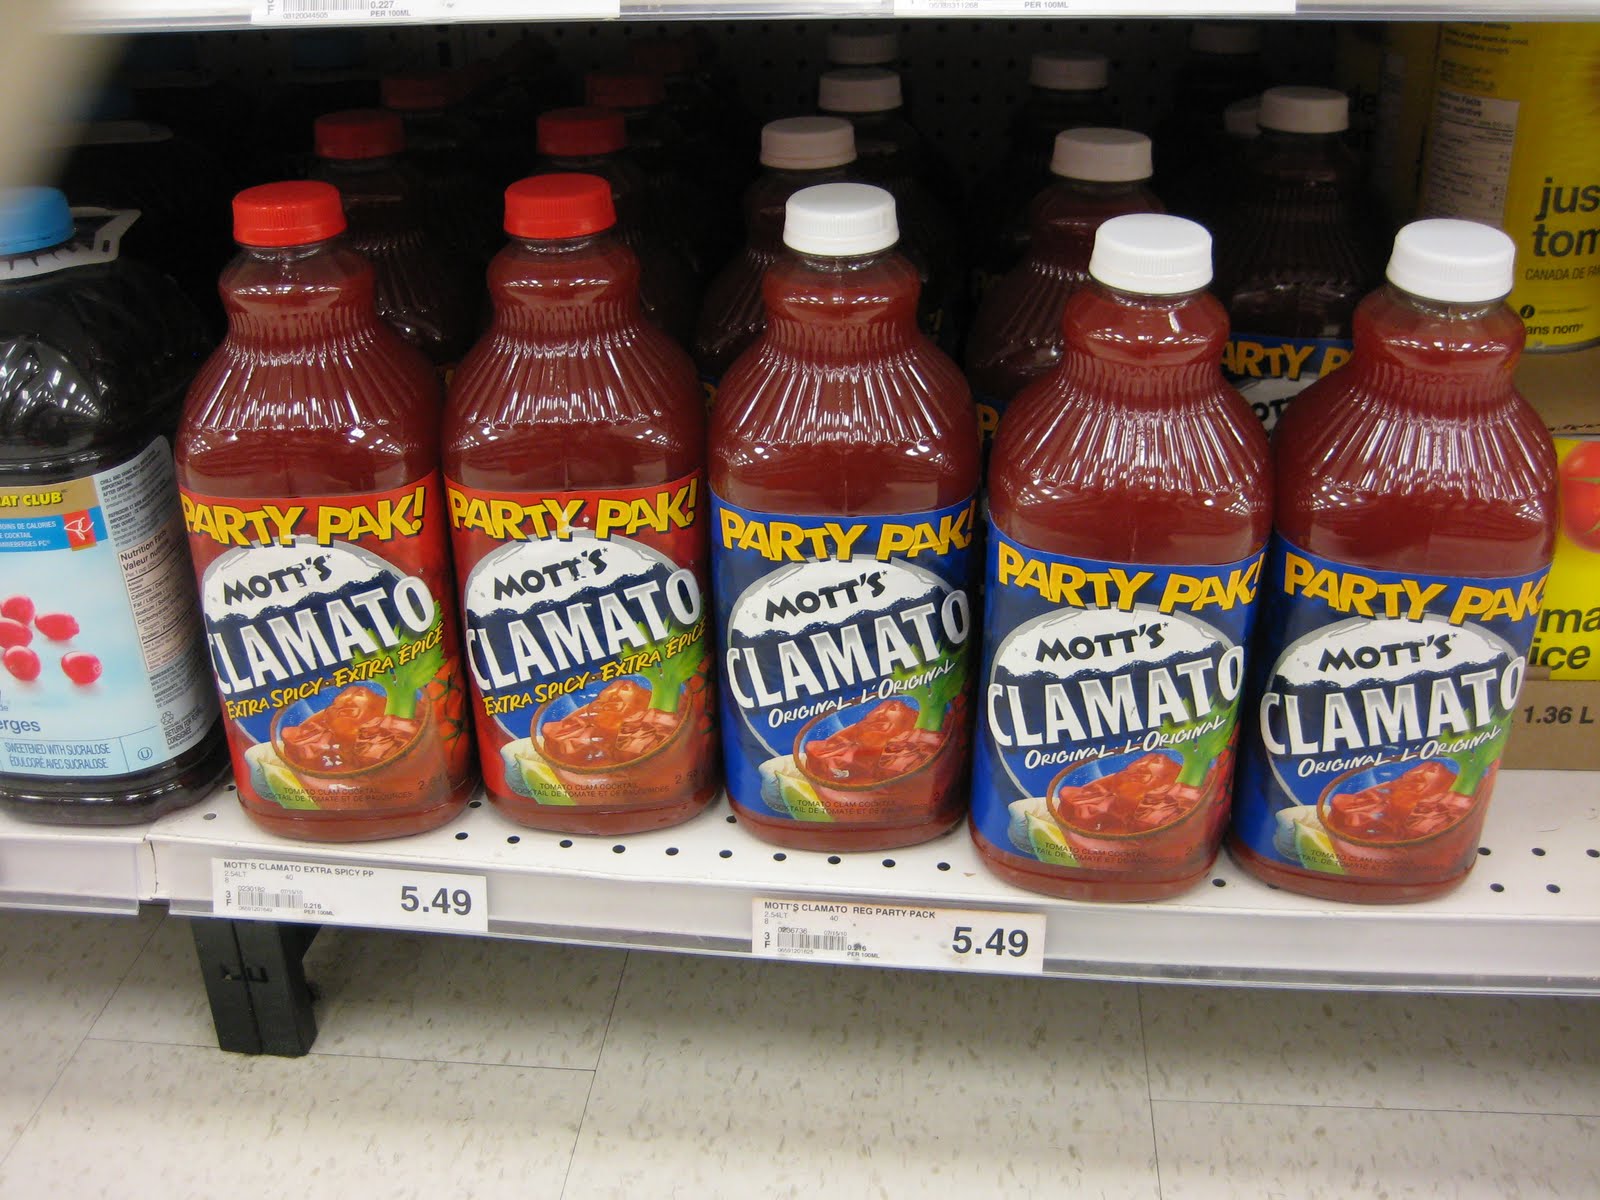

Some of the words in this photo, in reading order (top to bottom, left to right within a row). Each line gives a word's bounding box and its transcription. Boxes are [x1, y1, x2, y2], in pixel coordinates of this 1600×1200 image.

[370, 0, 394, 9] 0.227
[388, 9, 412, 17] 100ML
[1525, 268, 1570, 281] CANADA
[0, 494, 20, 508] AT
[22, 491, 64, 507] CLUB
[180, 492, 305, 547] PARTY
[318, 486, 425, 546] PAK!
[448, 487, 586, 541] PARTY
[595, 478, 698, 539] PAK!
[17, 522, 26, 530] DE
[26, 520, 57, 529] CALORIES
[720, 507, 868, 562] PARTY
[876, 500, 976, 561] PAK!
[120, 540, 154, 562] Nutrition
[123, 555, 148, 571] Valeur
[223, 555, 333, 606] MOTT'S
[494, 548, 608, 601] MOTT'S
[998, 541, 1155, 612] PARTY
[1158, 552, 1265, 614] PAK!
[1284, 552, 1448, 620] PARTY
[1448, 573, 1548, 626] PAK
[765, 570, 888, 623] MOTT'S
[466, 568, 701, 691] CLAMATO
[1036, 623, 1166, 663] MOTT'S
[726, 590, 970, 709] CLAMATO
[1318, 634, 1452, 673] MOTT'S
[1529, 637, 1590, 670] ice
[226, 697, 270, 721] EXTRA
[270, 676, 324, 710] SPICY
[333, 657, 394, 688] EXTRA
[398, 620, 445, 667] ÉPICÉ
[483, 695, 532, 717] EXTRA
[534, 675, 587, 704] SPICY
[600, 650, 662, 682] EXTRA
[666, 622, 706, 660] ÉPICÉ
[768, 697, 852, 728] ORIGINAL
[860, 660, 956, 705] L'ORIGINAL
[988, 645, 1244, 746] CLAMATO
[1260, 656, 1526, 756] CLAMATO
[1524, 706, 1573, 724] 1.36
[1579, 706, 1594, 724] L
[4, 742, 47, 754] SWEETENED
[46, 744, 66, 755] WITH
[66, 744, 112, 755] SUCRALOSE
[1024, 744, 1114, 770] ORIGINAL
[1124, 716, 1226, 753] L'ORIGINAL
[1298, 753, 1392, 778] ORIGINAL
[1402, 725, 1501, 760] L'ORIGINAL
[46, 758, 65, 769] AVEC
[65, 758, 109, 770] SUCRALOSE
[224, 861, 257, 870] MOTT'S
[258, 862, 302, 873] CLAMATO
[304, 866, 332, 875] EXTRA
[334, 868, 360, 878] SPICY
[362, 870, 374, 878] PP
[224, 870, 246, 878] 2.54LT
[226, 890, 231, 898] 3
[400, 885, 472, 916] 5.49
[764, 902, 799, 912] MOTT'S
[801, 904, 848, 914] CLAMATO
[852, 906, 873, 915] REG
[875, 907, 907, 918] PARTY
[909, 909, 936, 919] PACK
[764, 932, 770, 940] 3
[764, 940, 771, 948] F
[952, 926, 1030, 958] 5.49
